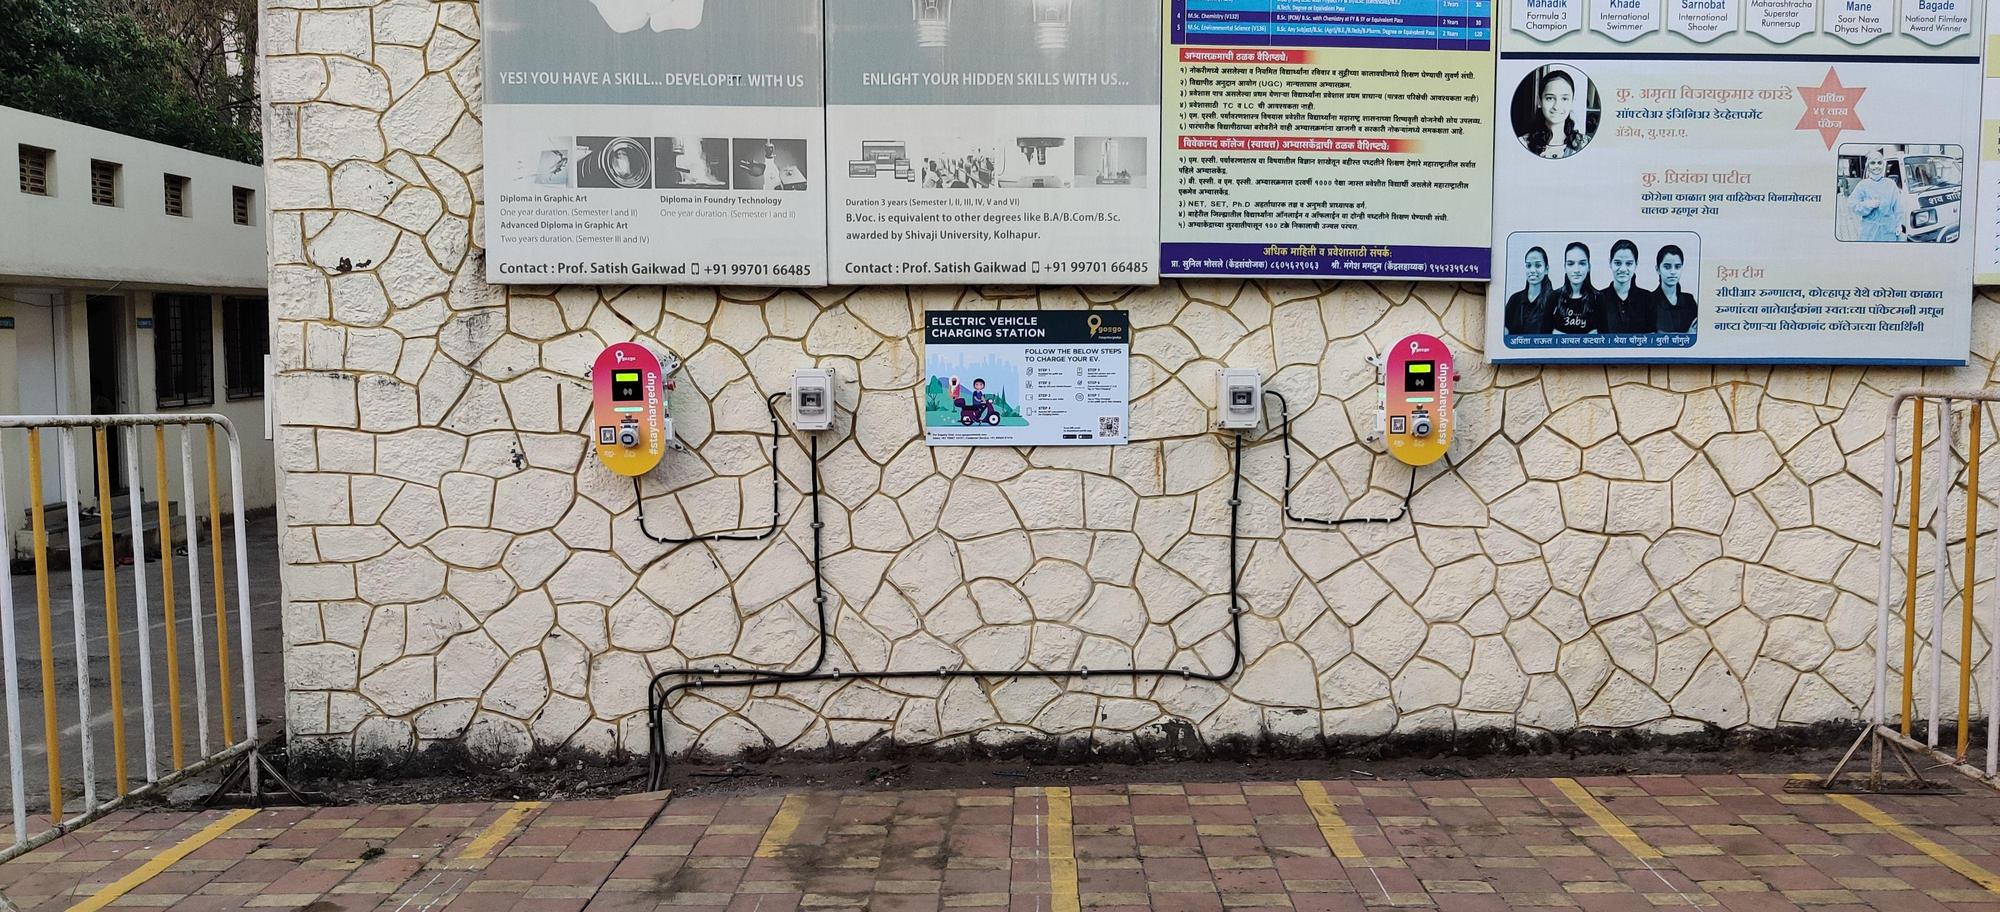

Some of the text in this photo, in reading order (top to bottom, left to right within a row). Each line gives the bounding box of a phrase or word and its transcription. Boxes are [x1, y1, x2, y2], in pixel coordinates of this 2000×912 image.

[1610, 0, 1640, 8] Khade
[1682, 0, 1724, 9] Sarnobat
[1751, 0, 1812, 8] Maharashtracha
[1846, 1, 1871, 11] Mane
[1919, 0, 1955, 12] Bagade
[1527, 12, 1558, 20] Formula
[1600, 12, 1650, 21] International
[1678, 13, 1727, 21] International
[1764, 10, 1798, 18] Superstar
[1762, 19, 1800, 28] Runnersup
[1838, 16, 1879, 24] Soor Nava
[1905, 15, 1967, 23] National Filmfare
[1526, 22, 1567, 31] Champion
[1606, 22, 1642, 30] Swimmer
[1688, 22, 1717, 30] Shooter
[1835, 25, 1858, 34] Dhyas
[499, 72, 526, 83] YES!
[530, 71, 558, 84] YOU
[563, 72, 598, 84] HAVE
[602, 72, 610, 84] A
[614, 72, 662, 85] SKILL...
[748, 74, 782, 86] WITH
[787, 74, 803, 86] US
[863, 72, 1128, 85] ENLIGHT YOUR HIDDEN SKILLS WITH US...
[500, 193, 586, 203] Diploma in Graphic Art
[660, 194, 781, 205] Diploma in Foundry Technology
[846, 197, 879, 206] Duration
[887, 199, 907, 208] years
[909, 197, 946, 207] (Semester
[975, 197, 984, 207] IV,
[993, 197, 1007, 206] and
[1009, 197, 1019, 207] VI)
[500, 207, 515, 217] One
[517, 208, 533, 218] year
[571, 207, 608, 217] (Semester
[614, 207, 628, 217] and
[846, 212, 1120, 224] B.Voc. is equivalent to other degrees like B.A/B.Com/B.Sc.
[500, 220, 627, 230] Advanced Diploma in Graphic Art
[500, 234, 516, 243] Two
[518, 234, 538, 244] years
[576, 234, 612, 243] (Semester
[623, 235, 637, 243] and
[639, 235, 649, 245] IV)
[846, 230, 1040, 241] awarded by Shivaji University, Kolhapur.
[500, 262, 810, 275] Contact Prof. Satish Gaikwad +91 99701 66485
[845, 261, 1147, 272] Contact Prof. Satish Gaikwad +91 99701 66485
[932, 316, 1037, 326] ELECTRIC VEHICLE
[932, 328, 1045, 337] CHARGING STATION
[1025, 347, 1121, 355] FOLLOW THE BELOW STEPS
[1036, 355, 1065, 363] CHARGE
[1067, 355, 1087, 363] YOUR
[1437, 363, 1449, 445] #staychargedup
[646, 372, 659, 455] #staychargedup
